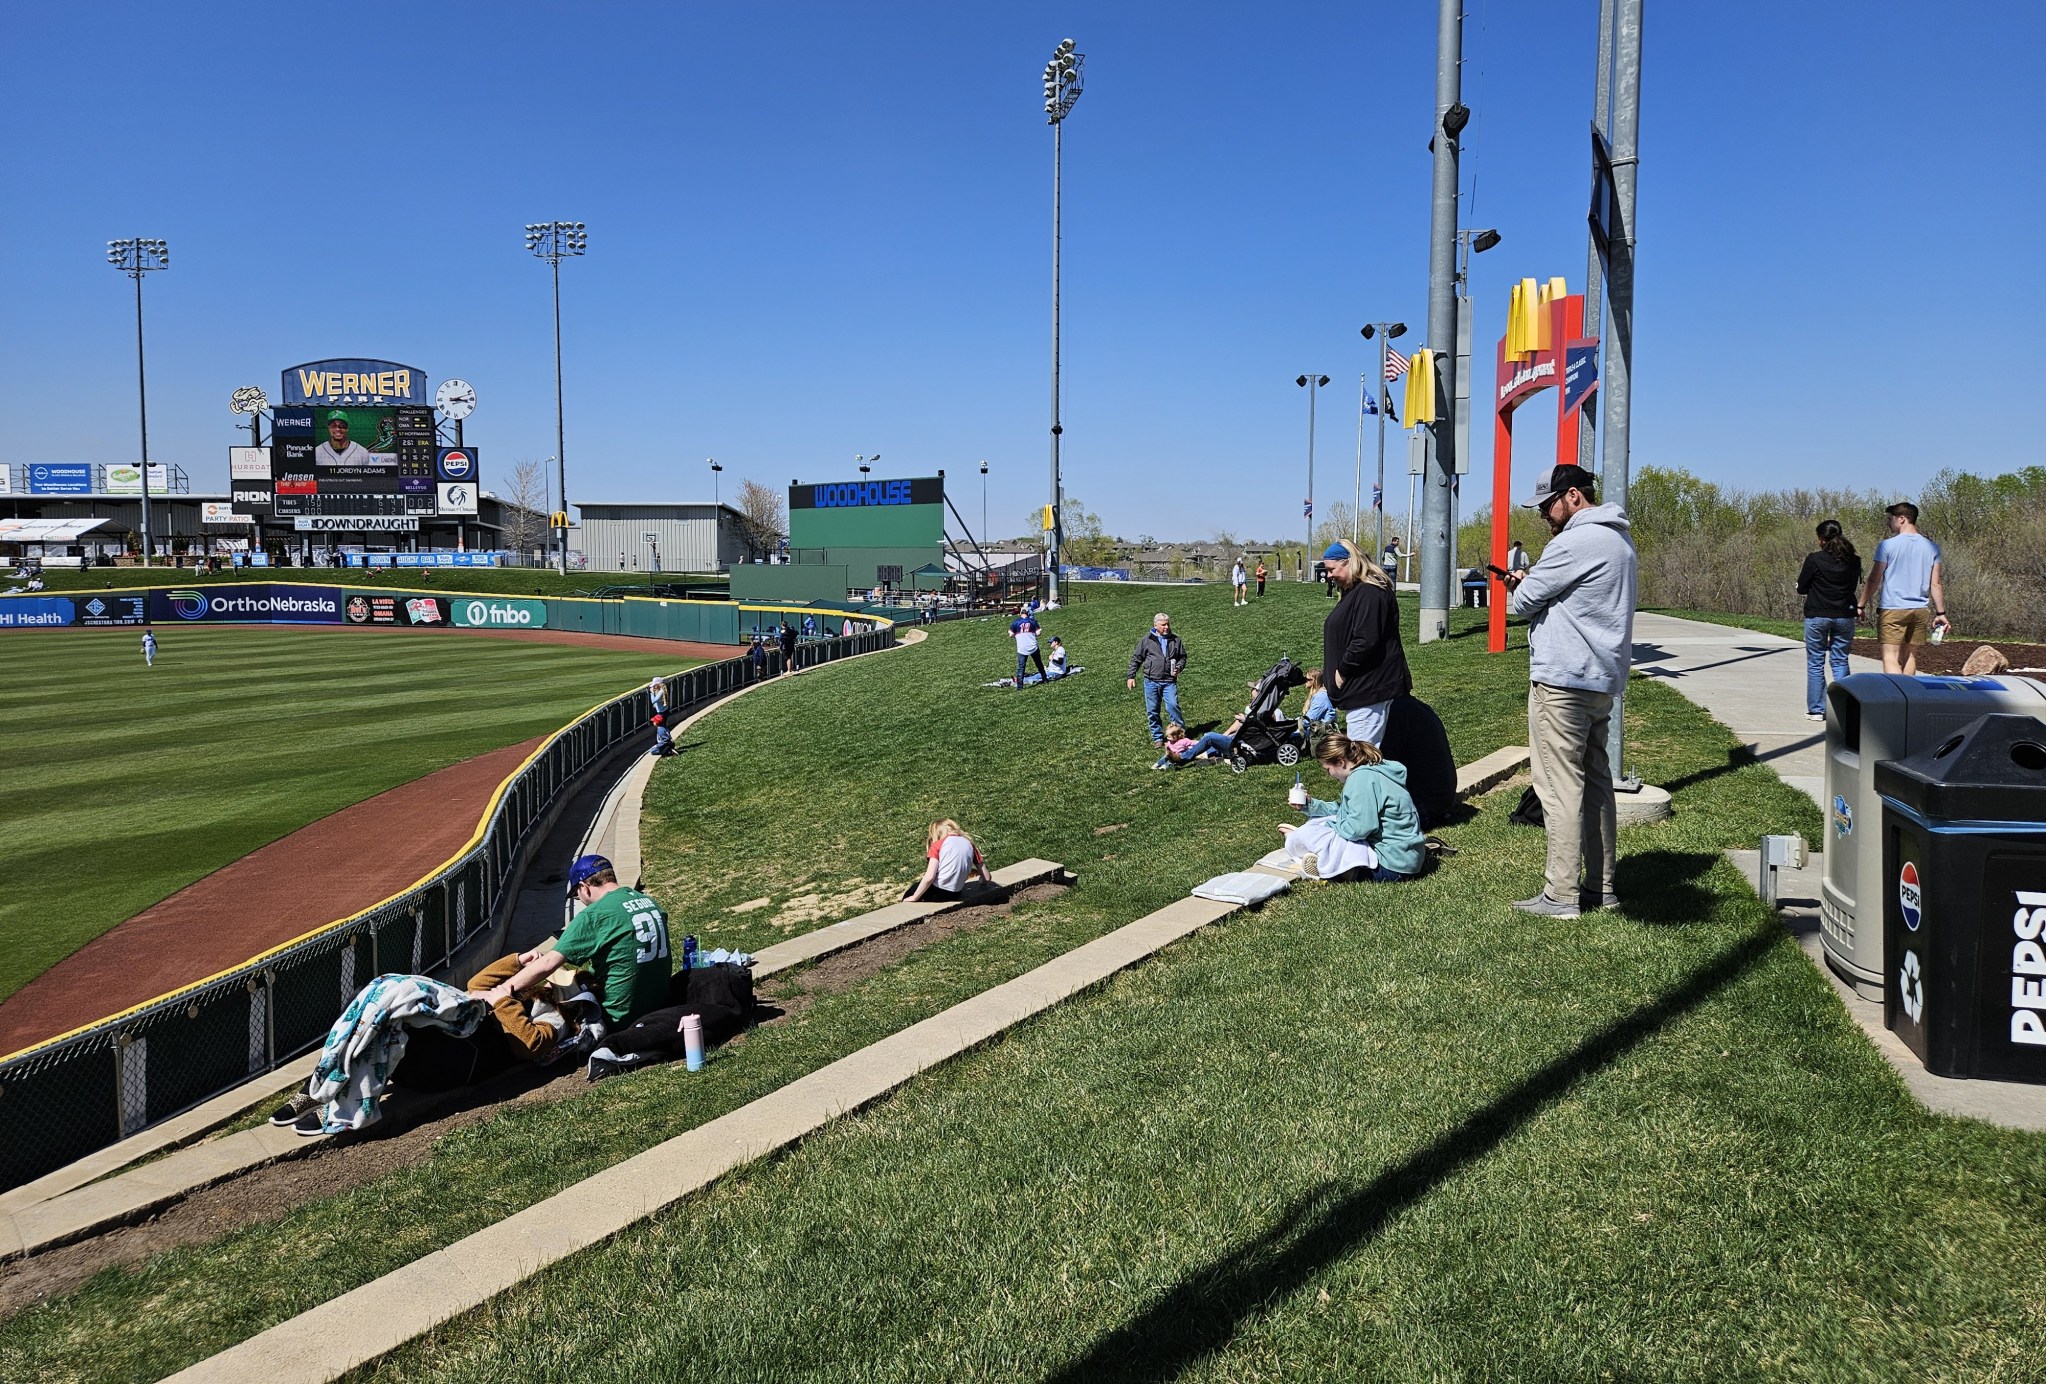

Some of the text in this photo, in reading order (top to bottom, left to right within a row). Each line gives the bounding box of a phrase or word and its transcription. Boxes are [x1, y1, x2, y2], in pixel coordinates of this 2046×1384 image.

[299, 369, 411, 398] WERNER
[276, 418, 311, 427] WERNER
[282, 472, 314, 481] Jensen
[233, 491, 271, 503] RION
[815, 480, 912, 508] WOODHOUSE
[317, 518, 416, 530] DOWNDRAUGHT
[211, 596, 336, 613] OrthoNebraska
[0, 612, 61, 624] HI Health
[489, 604, 531, 624] fnbo
[1901, 884, 1920, 908] PEPSI
[632, 909, 668, 964] 91
[2010, 890, 2046, 1046] PEPSI
